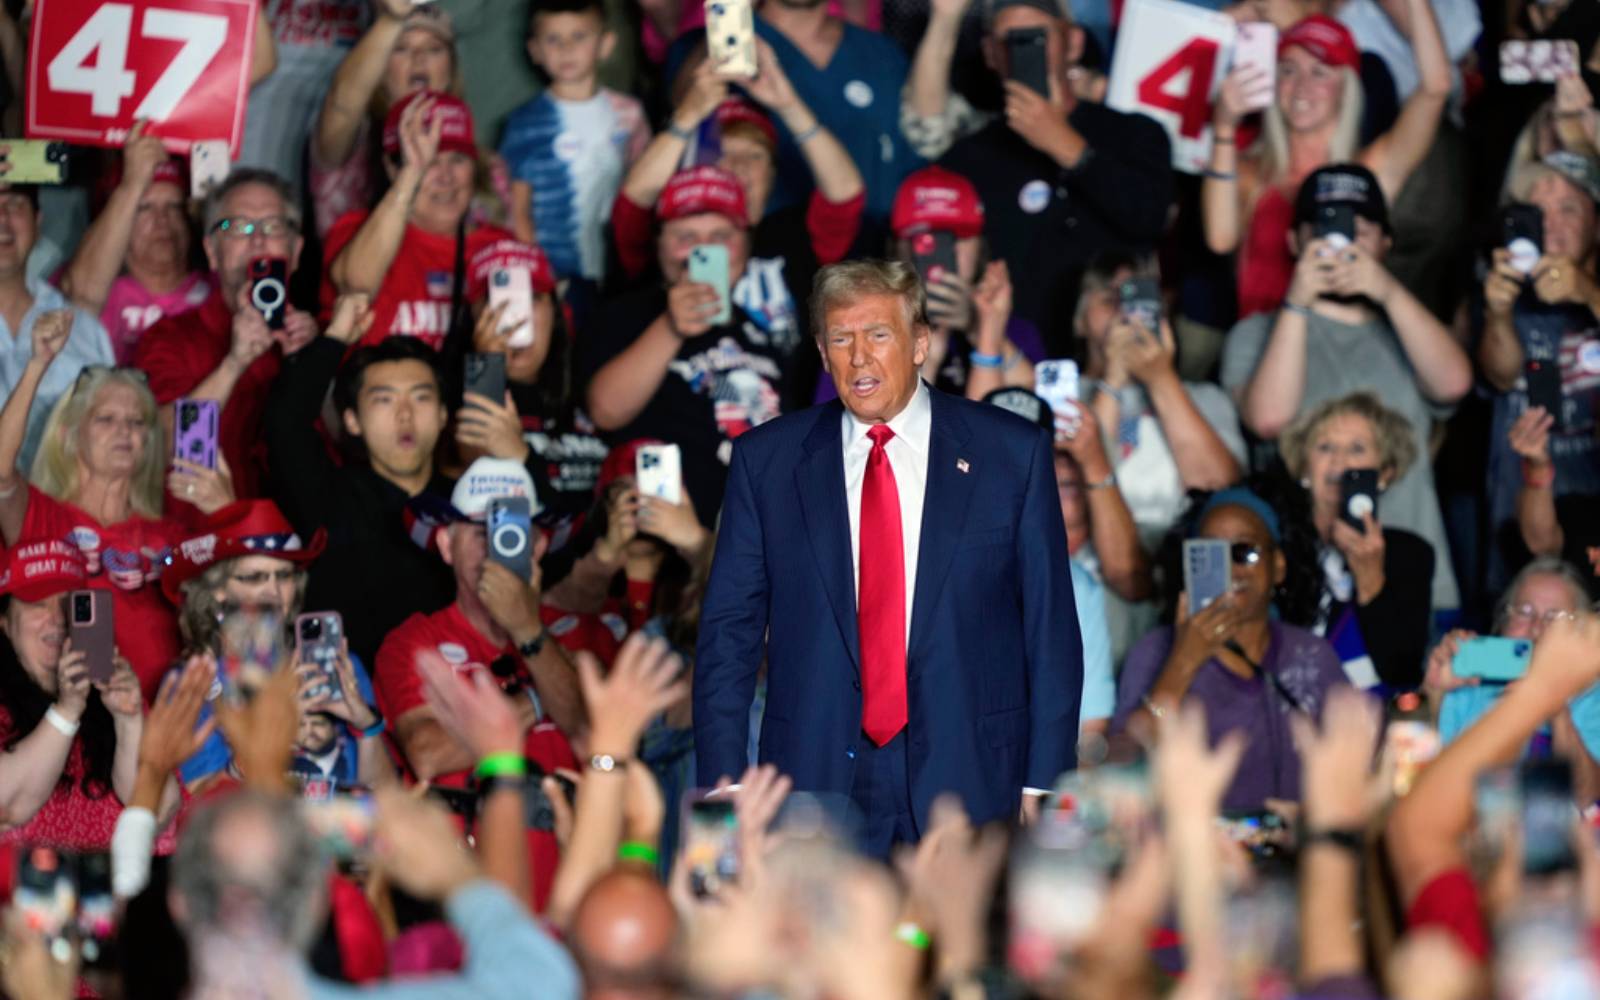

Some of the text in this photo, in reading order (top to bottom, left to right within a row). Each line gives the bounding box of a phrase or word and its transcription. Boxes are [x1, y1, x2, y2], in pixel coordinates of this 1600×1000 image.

[46, 3, 229, 124] 47
[1136, 36, 1221, 140] 4
[25, 559, 56, 579] GREAT
